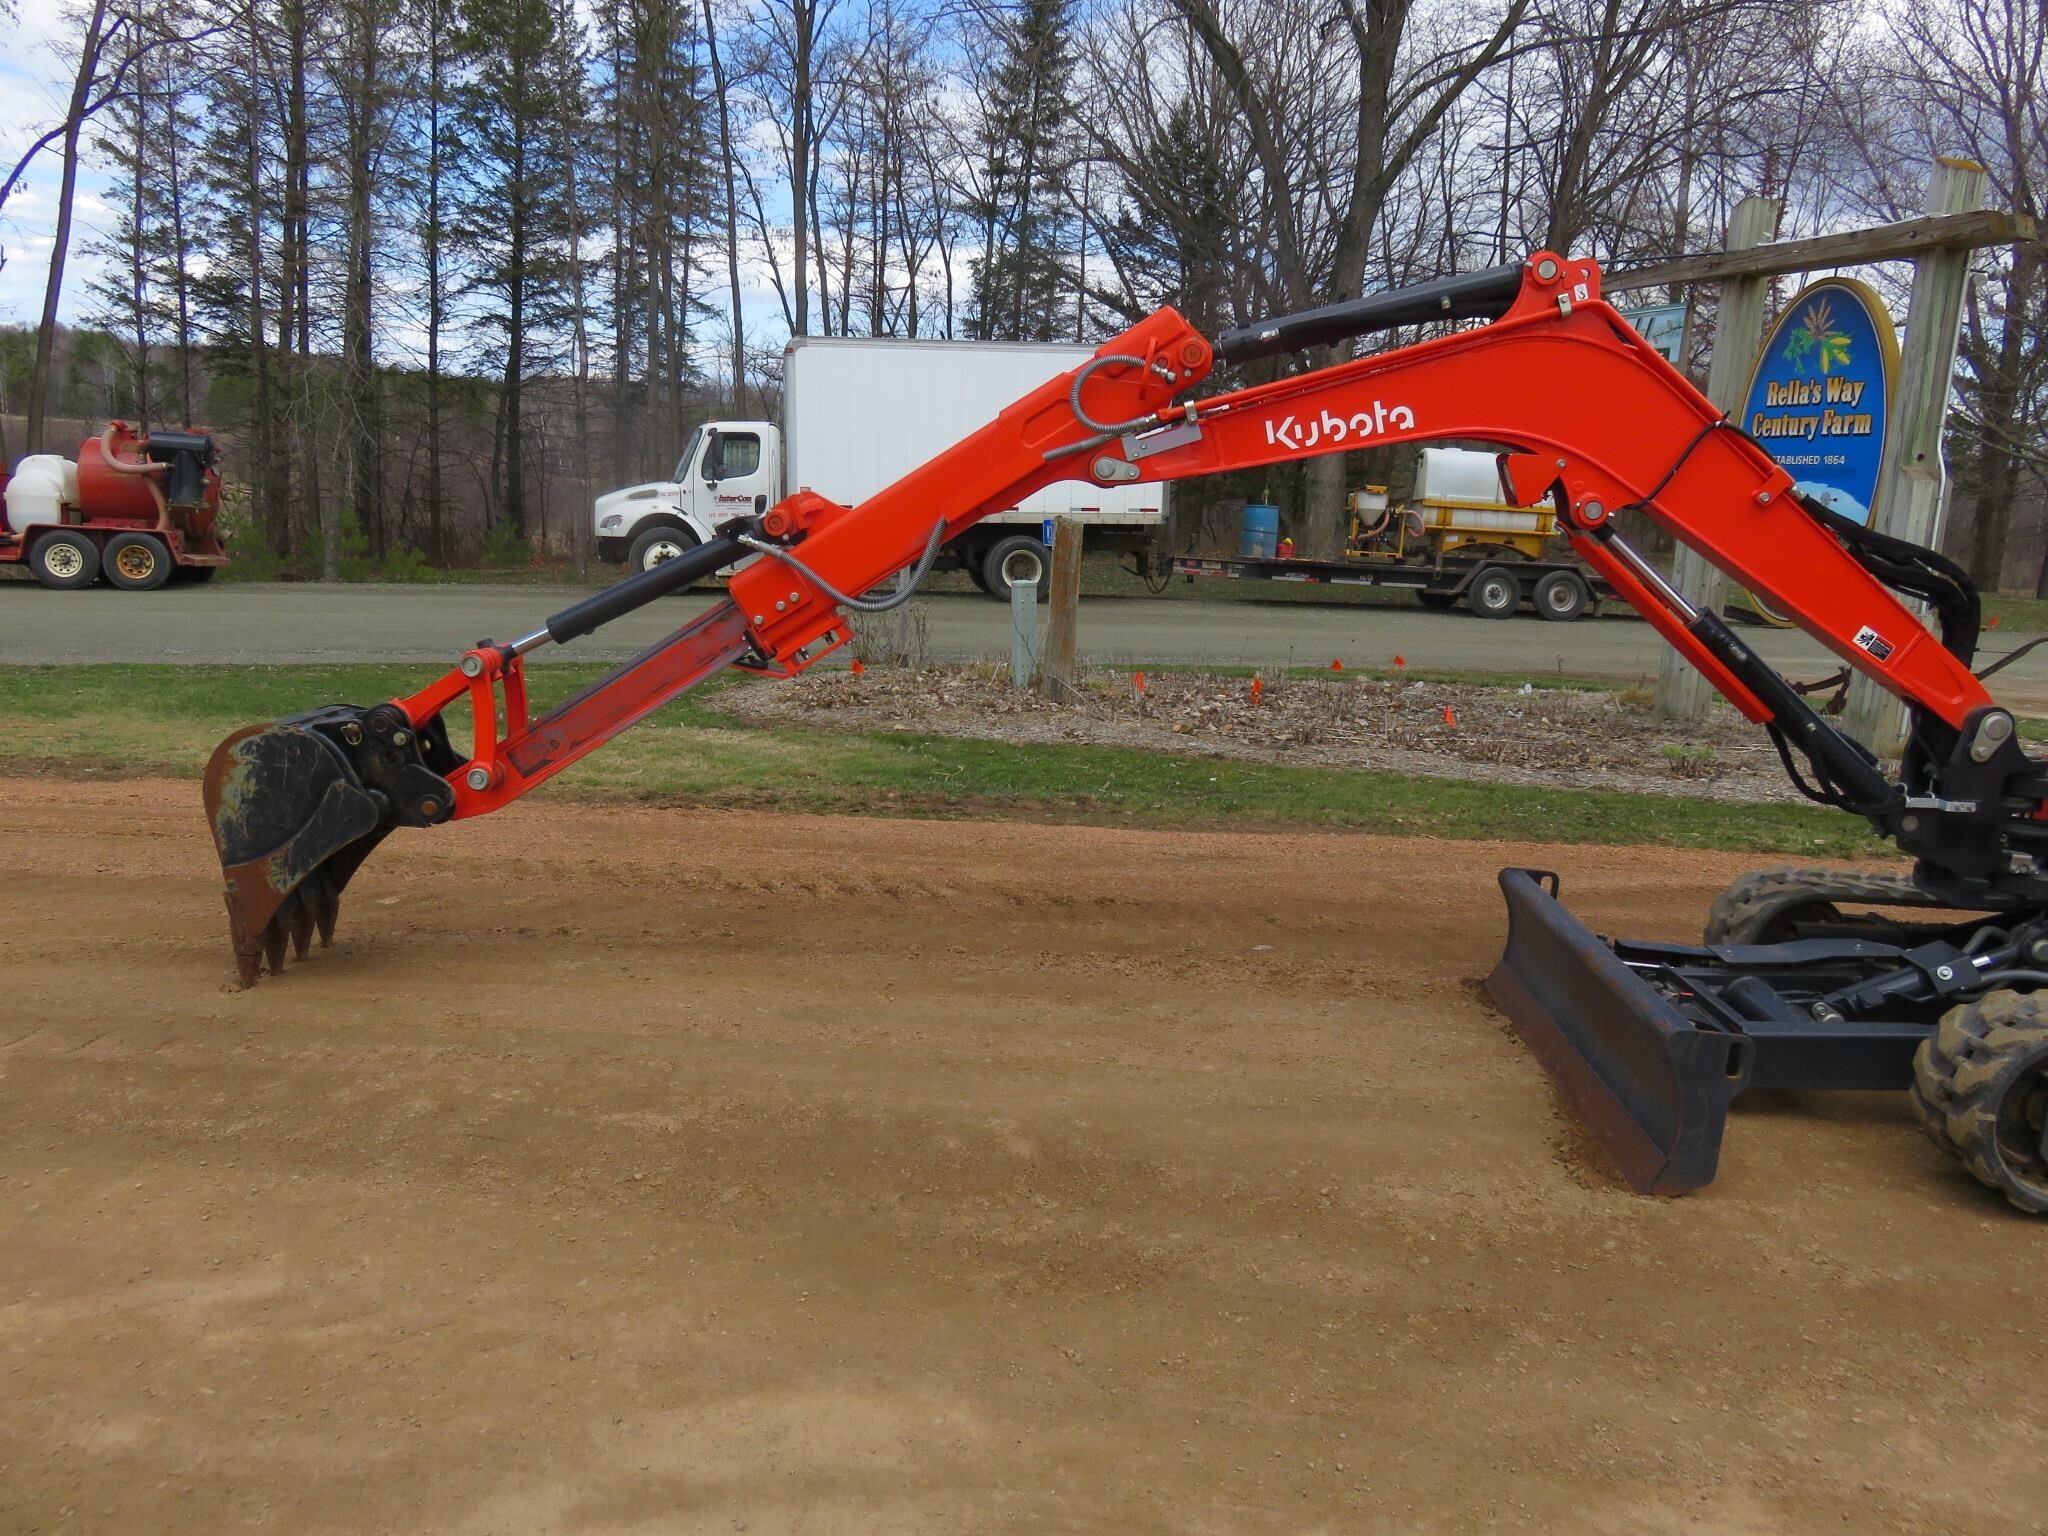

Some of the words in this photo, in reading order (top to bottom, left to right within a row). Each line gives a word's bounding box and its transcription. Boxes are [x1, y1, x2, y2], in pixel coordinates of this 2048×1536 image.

[1766, 379, 1822, 407] Rella's
[1826, 377, 1865, 407] Way
[1264, 400, 1415, 450] Kubota
[1752, 412, 1820, 441] Century
[1821, 409, 1872, 436] Farm
[1773, 455, 1820, 465] TABLISHED
[1823, 455, 1845, 465] 1864
